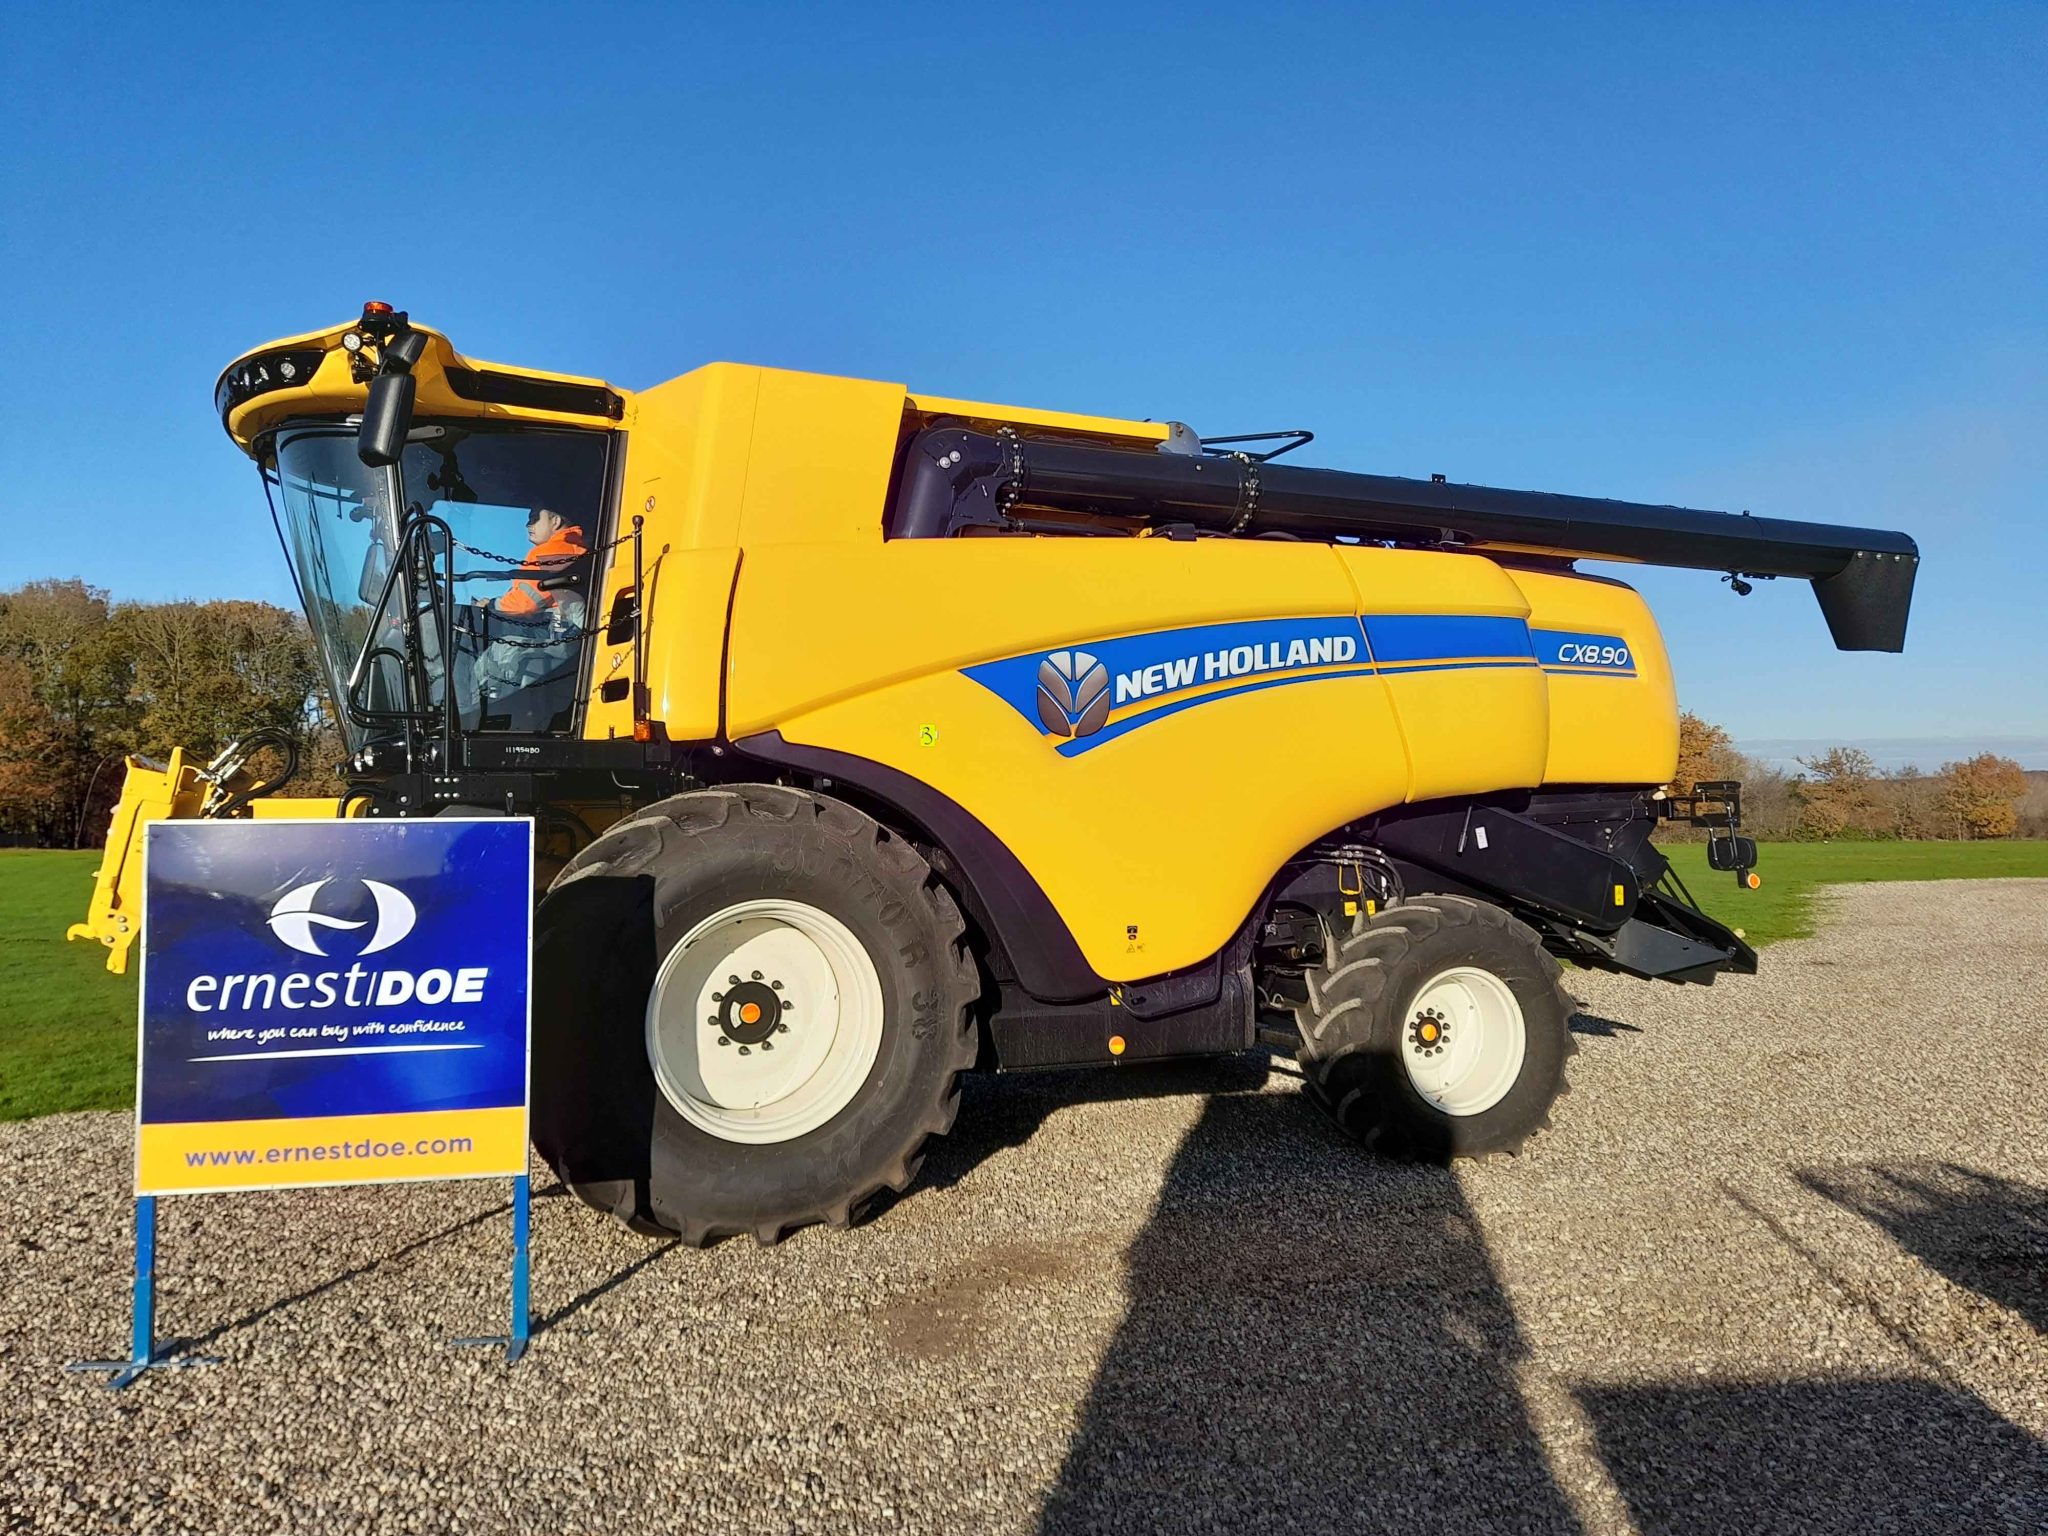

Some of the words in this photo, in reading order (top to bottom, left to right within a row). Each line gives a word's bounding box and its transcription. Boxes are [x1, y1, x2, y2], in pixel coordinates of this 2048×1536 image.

[1115, 656, 1198, 703] NEW
[1204, 636, 1356, 681] HOLLAND
[1558, 643, 1628, 666] CX8.90
[186, 962, 367, 1012] ernest
[375, 967, 489, 1007] DOE
[207, 1027, 255, 1041] where
[257, 1027, 286, 1045] you
[290, 1027, 317, 1038] can
[321, 1025, 348, 1042] buy
[352, 1021, 385, 1036] with
[388, 1019, 465, 1034] confidence
[185, 1137, 472, 1167] www.ernestdoe.com
